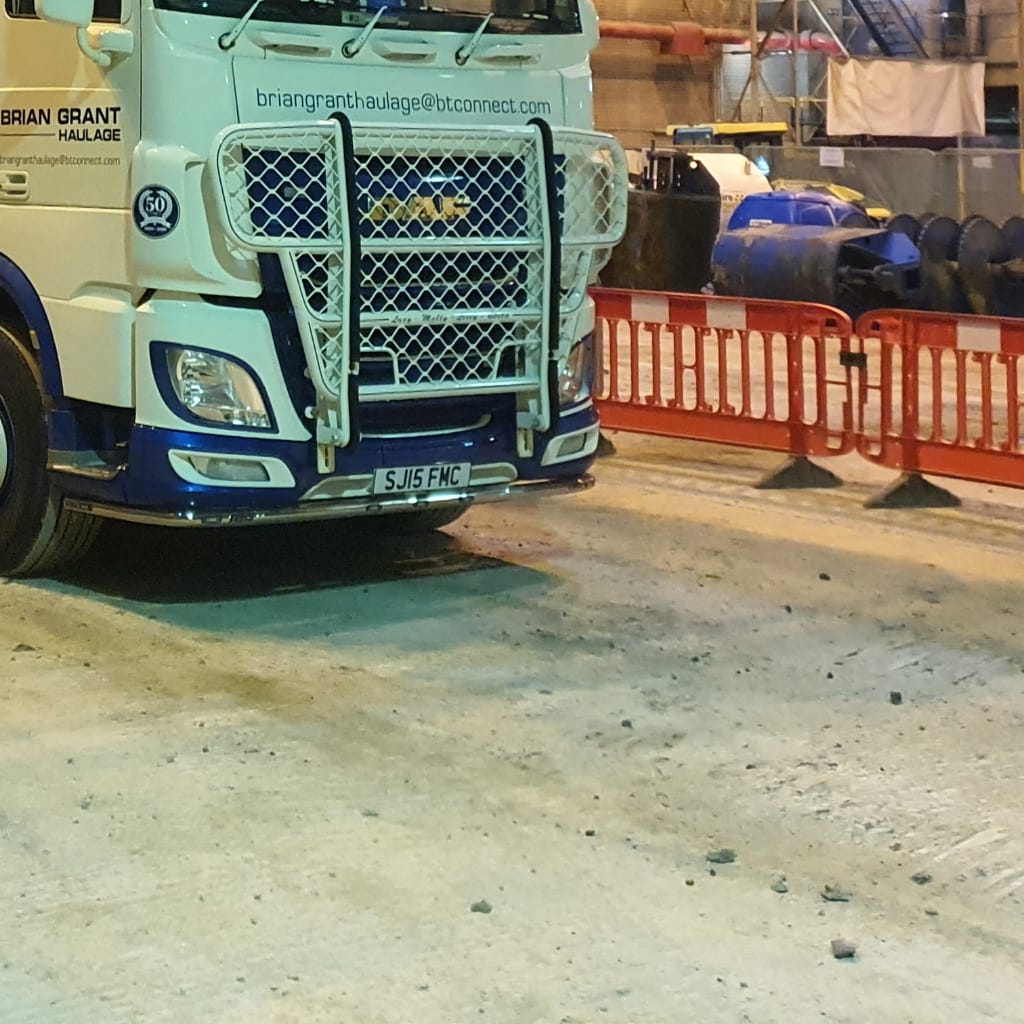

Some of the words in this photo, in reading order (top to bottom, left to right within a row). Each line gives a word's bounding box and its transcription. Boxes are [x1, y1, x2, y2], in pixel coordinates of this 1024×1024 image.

[256, 87, 551, 116] briangranthaulage@btconnect.com
[0, 108, 51, 125] BRIAN
[57, 106, 121, 125] GRANT
[58, 128, 121, 142] HAULAGE
[0, 154, 121, 167] briangranthaulage@btconnect.com
[145, 196, 166, 213] 50
[384, 468, 423, 490] SJ15
[427, 465, 461, 487] FMC
